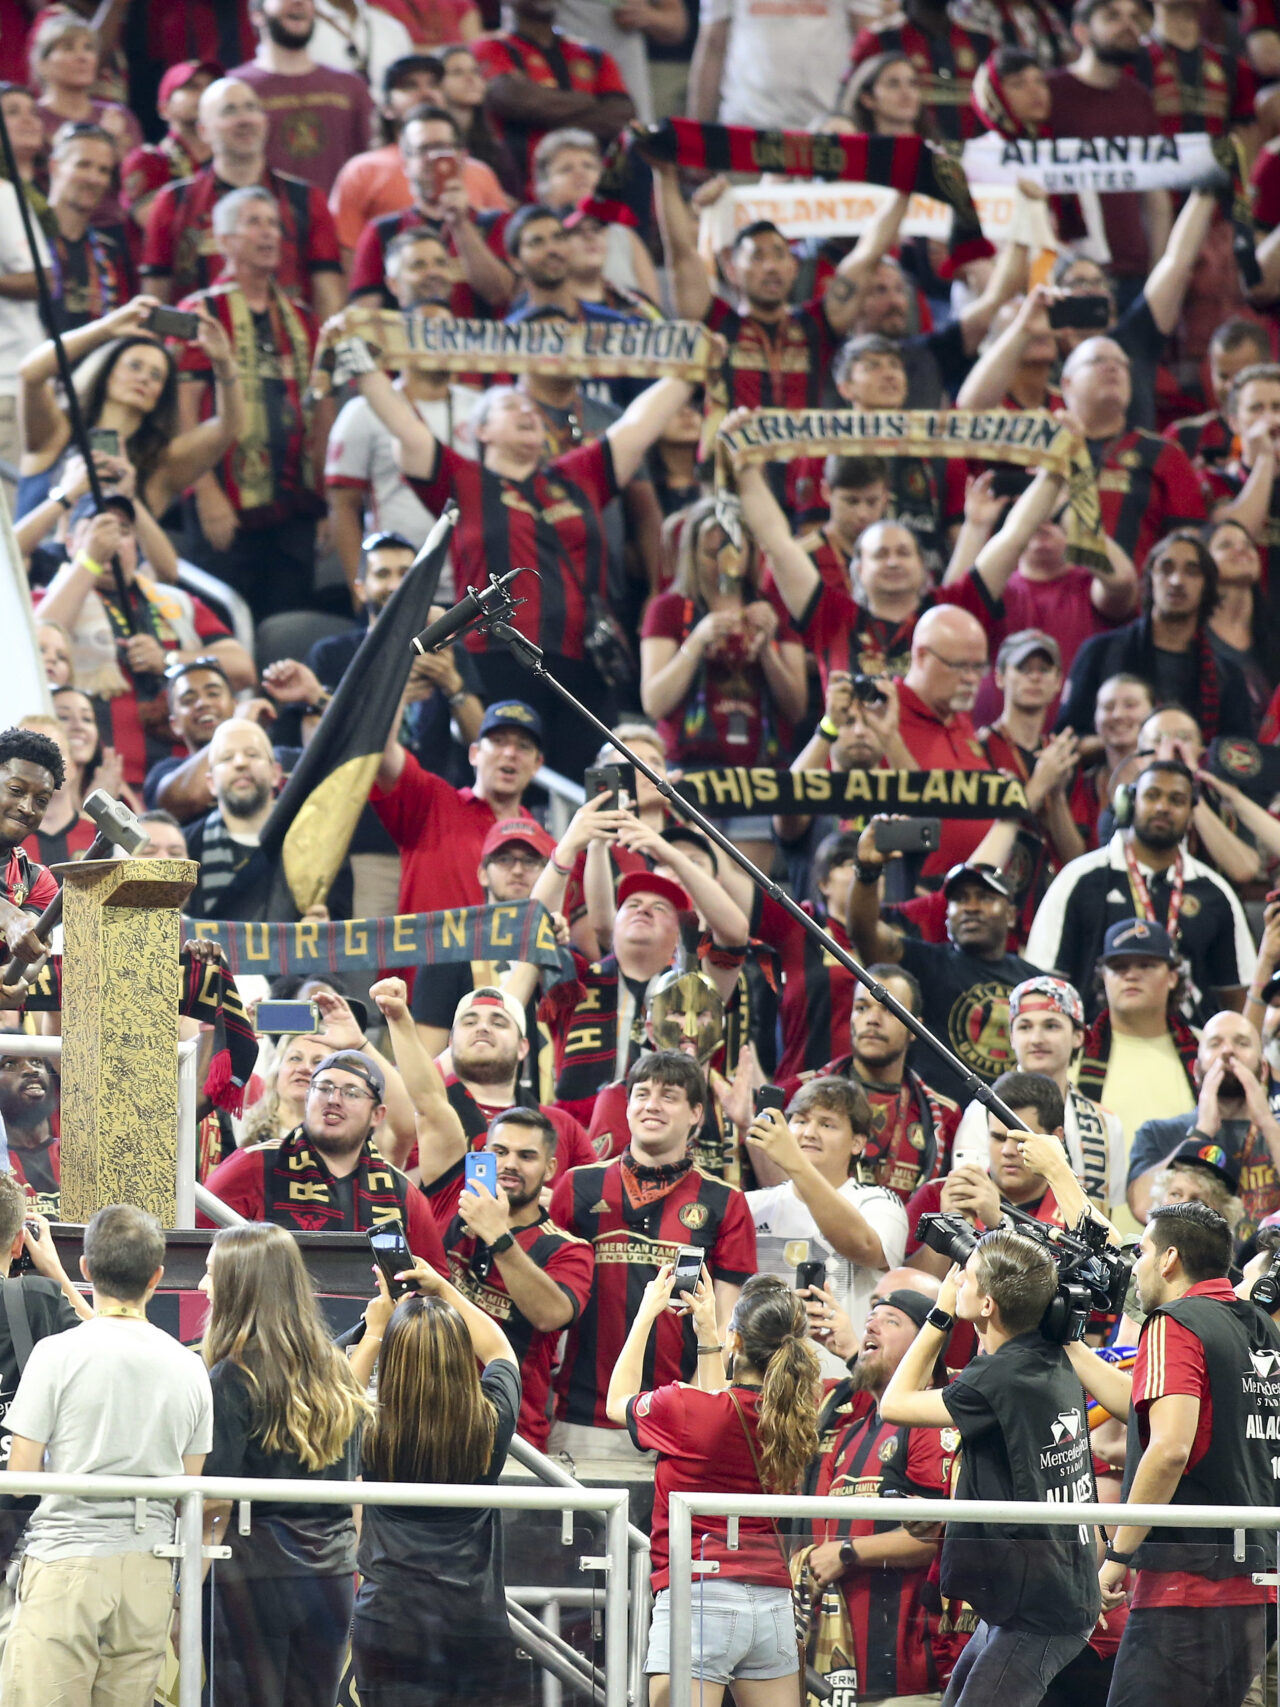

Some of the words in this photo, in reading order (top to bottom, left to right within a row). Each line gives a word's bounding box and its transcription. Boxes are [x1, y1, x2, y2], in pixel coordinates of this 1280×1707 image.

[1043, 170, 1138, 189] UNITED
[403, 315, 569, 357] TERMINUS
[582, 319, 703, 361] LEGION
[926, 414, 1063, 452] LEGION
[683, 767, 780, 810] THIS
[793, 770, 833, 800] IS
[843, 768, 1028, 809] ATLANTA
[651, 1245, 678, 1258] FAMI
